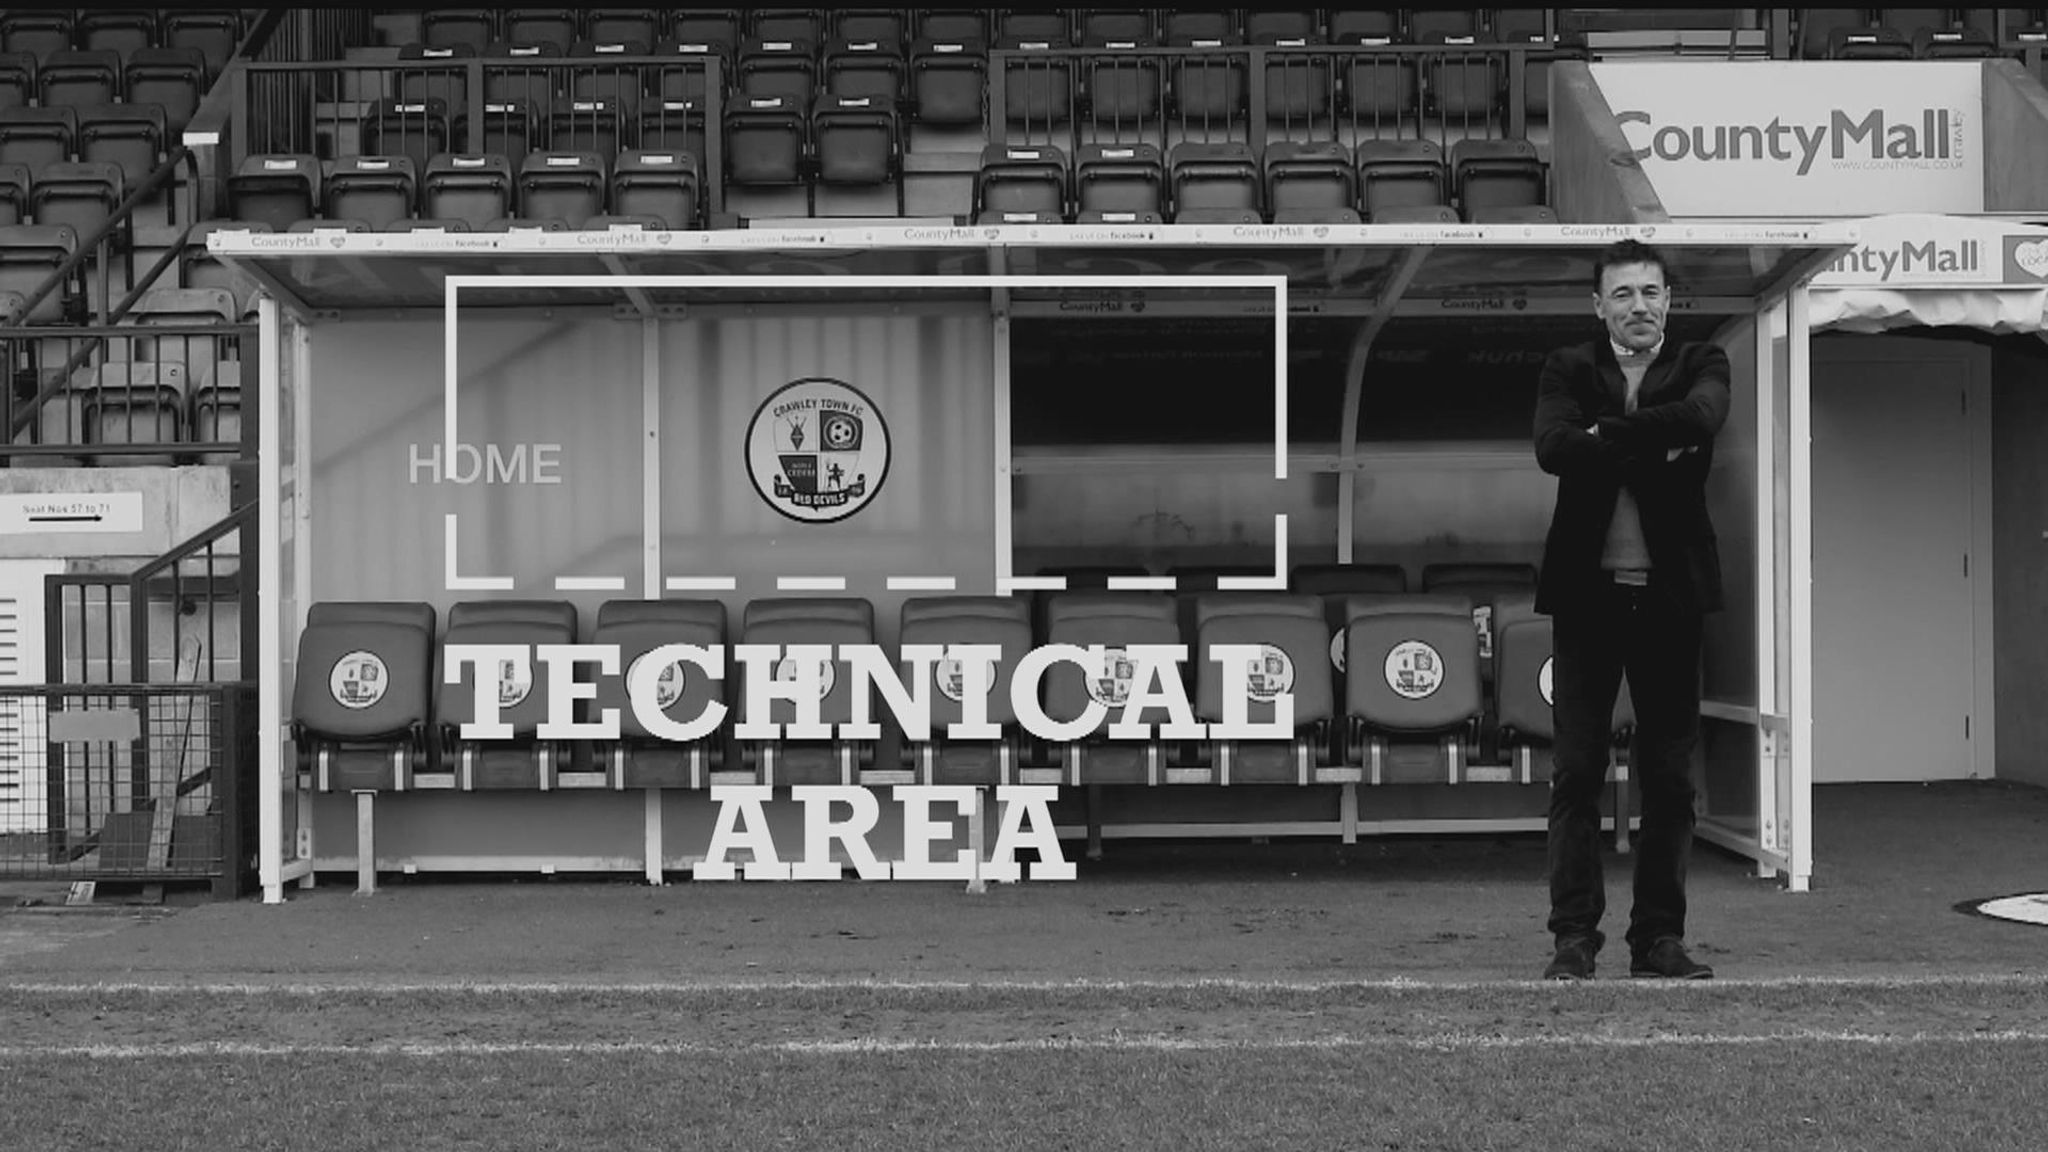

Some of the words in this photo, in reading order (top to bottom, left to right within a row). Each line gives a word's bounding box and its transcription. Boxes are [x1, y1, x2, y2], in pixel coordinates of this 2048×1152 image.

[904, 228, 975, 240] CountyMall
[1233, 226, 1304, 239] CountyMall
[1561, 225, 1631, 237] CountyMall
[251, 237, 320, 249] CountyMall
[577, 233, 647, 245] CountyMall
[820, 399, 849, 411] TOWN
[408, 443, 562, 484] HOME
